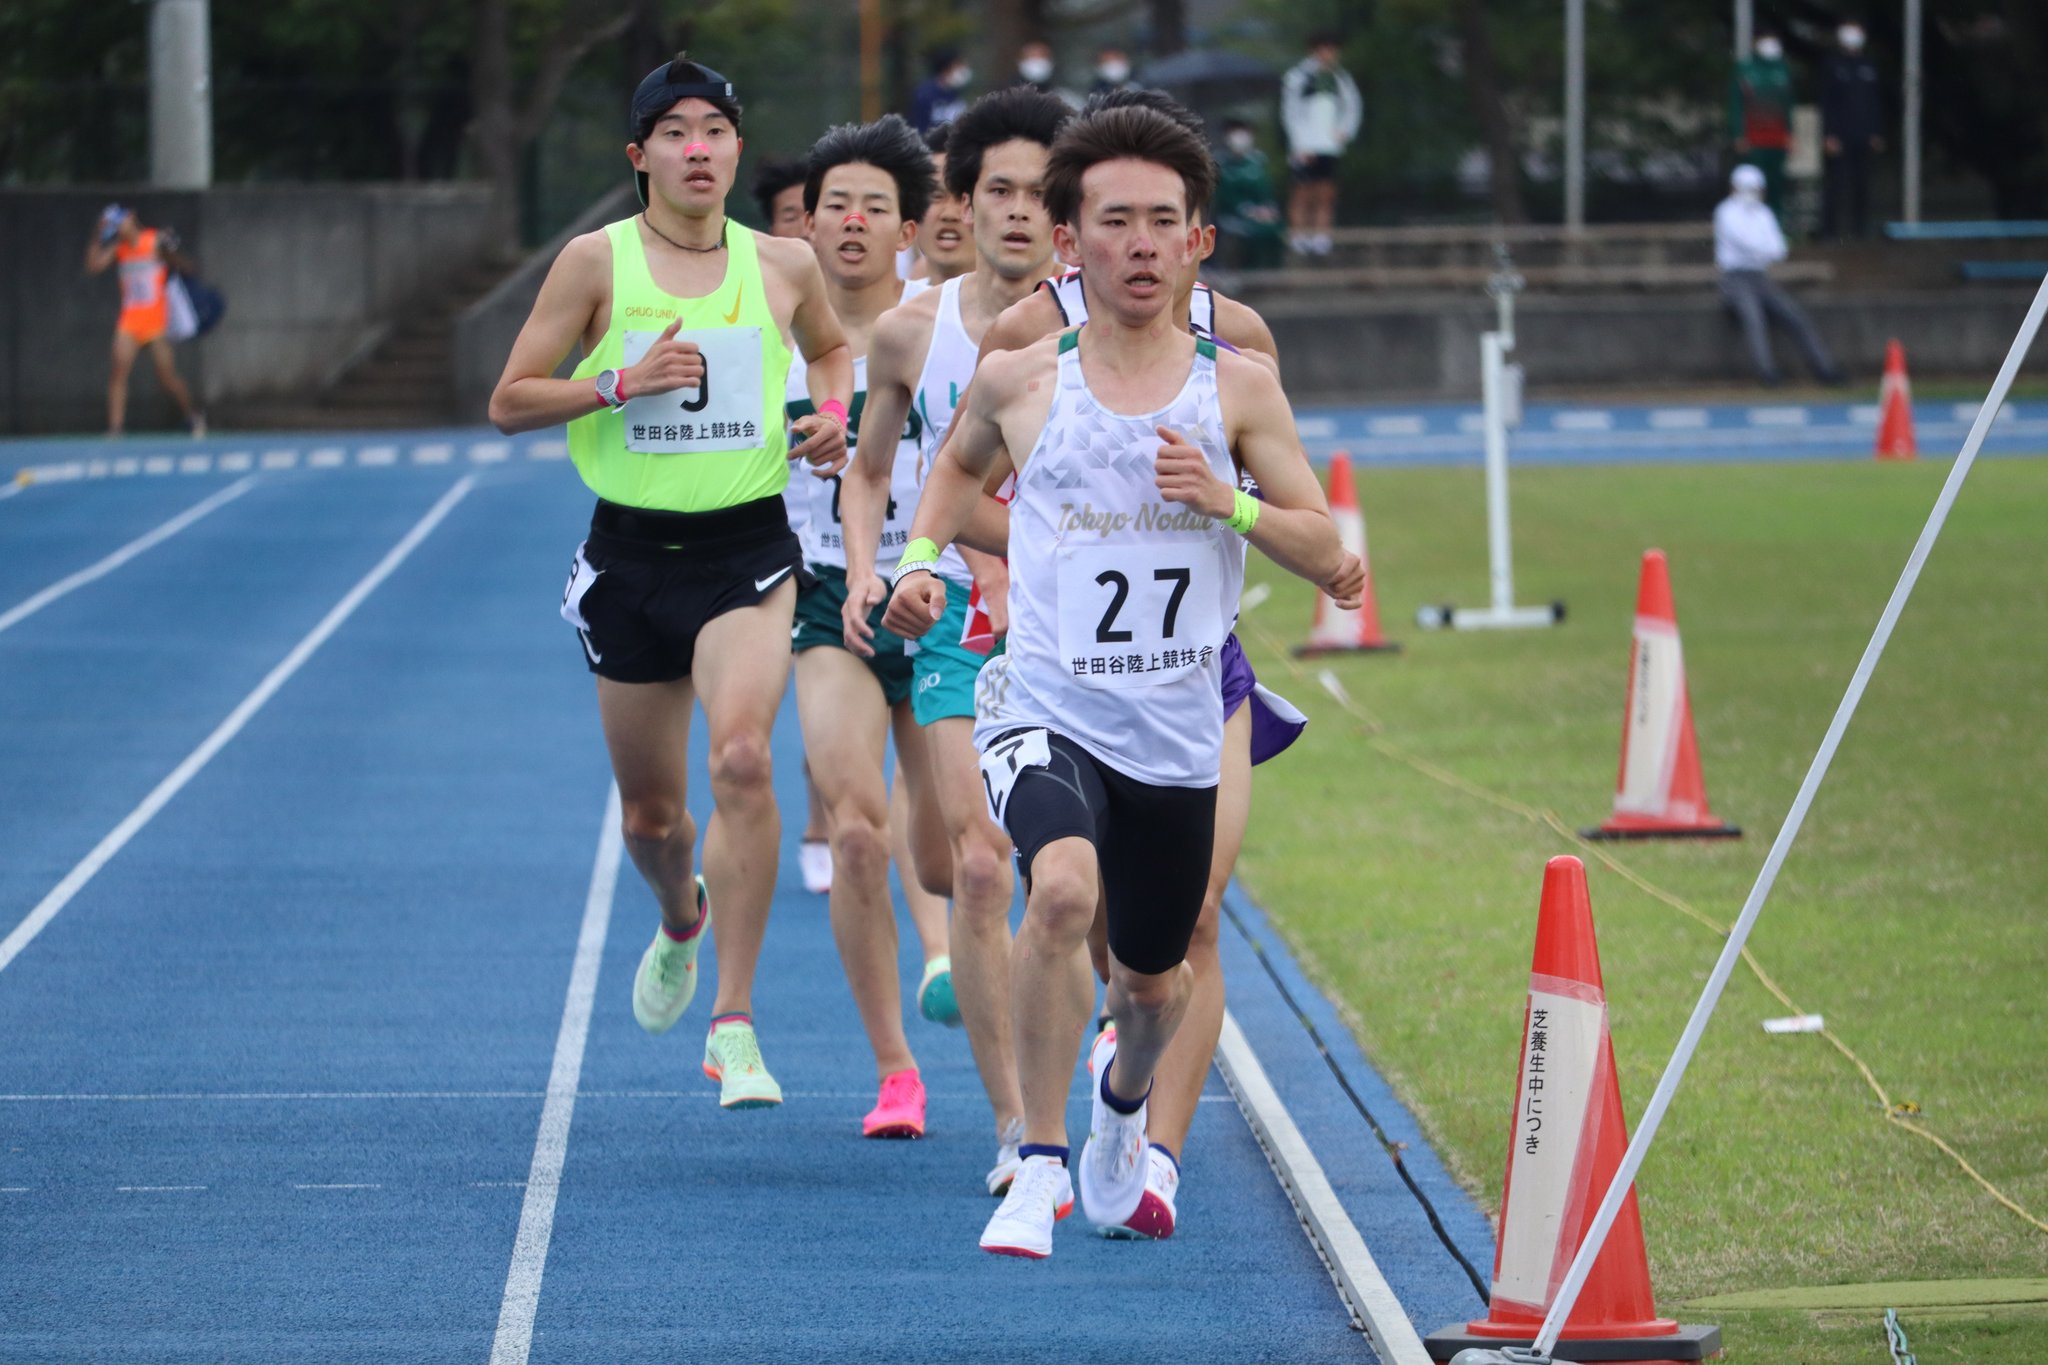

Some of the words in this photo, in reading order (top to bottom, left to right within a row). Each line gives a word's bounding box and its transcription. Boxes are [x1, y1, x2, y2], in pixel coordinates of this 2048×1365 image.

[624, 306, 653, 317] CHUO
[632, 421, 756, 442] 世田谷陸上競技会
[1057, 503, 1132, 538] Tokyo
[1095, 567, 1191, 643] 27
[1072, 645, 1213, 676] 世田谷陸上競技会
[1525, 1008, 1549, 1155] 芝養生中につき
